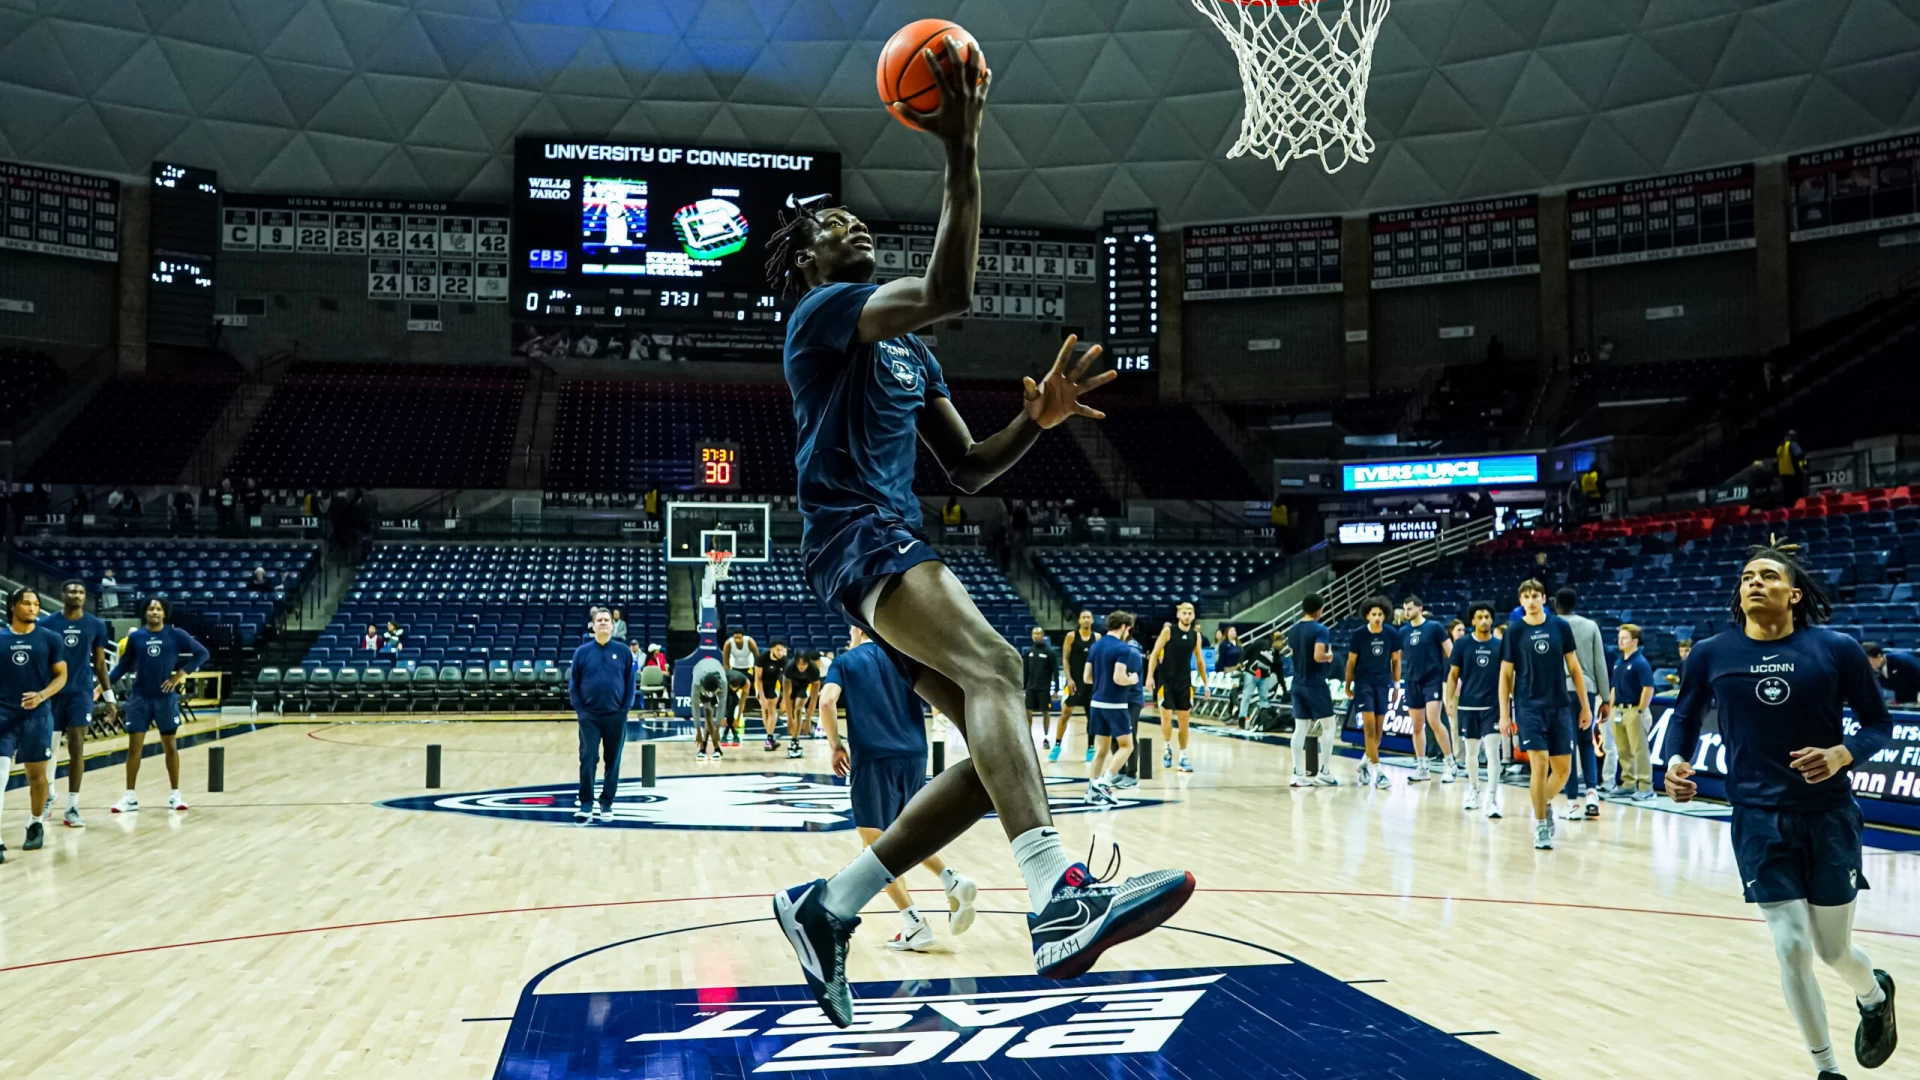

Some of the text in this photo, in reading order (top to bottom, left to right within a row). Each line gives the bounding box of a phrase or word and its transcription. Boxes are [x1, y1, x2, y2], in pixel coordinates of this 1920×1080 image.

[545, 143, 814, 172] UNIVERSITY OF CONNECTICUT
[528, 177, 571, 189] WELLS
[1577, 167, 1742, 200] NCAA CHAMPIONSHIP
[529, 188, 571, 200] FARGO
[288, 197, 328, 206] UCONN
[333, 199, 383, 209] HUSKIES
[409, 203, 449, 211] HONOR
[1379, 197, 1528, 223] NCAA CHAMPIONSHIP
[232, 227, 248, 242] C
[272, 228, 282, 243] 9
[899, 224, 935, 232] UCONN
[1192, 219, 1334, 237] NCAA CHAMPIONSHIP
[301, 229, 326, 245] 22
[337, 231, 363, 246] 25
[374, 232, 399, 248] 42
[410, 233, 434, 249] 44
[480, 236, 505, 251] 42
[1191, 234, 1257, 246] TOURNAMENT
[373, 275, 397, 291] 24
[411, 276, 431, 292] 13
[445, 278, 469, 293] 22
[526, 292, 539, 311] 0
[660, 290, 699, 307] 37:31
[980, 297, 994, 312] 13
[1042, 299, 1057, 316] C
[1116, 355, 1150, 370] 11:15
[702, 448, 734, 462] 37:31
[706, 462, 730, 484] 30
[1354, 462, 1479, 482] EVERSOURCE
[46, 513, 65, 524] 113
[402, 518, 419, 529] 114
[642, 520, 660, 530] 114
[963, 524, 980, 535] 116
[1050, 525, 1066, 536] 117
[1260, 527, 1276, 537] 117
[1388, 521, 1438, 532] MICHAELS
[1391, 530, 1436, 541] JEWELERS
[1750, 663, 1795, 673] UCONN
[625, 989, 1207, 1043] EAST
[752, 1018, 1184, 1073] BIG
